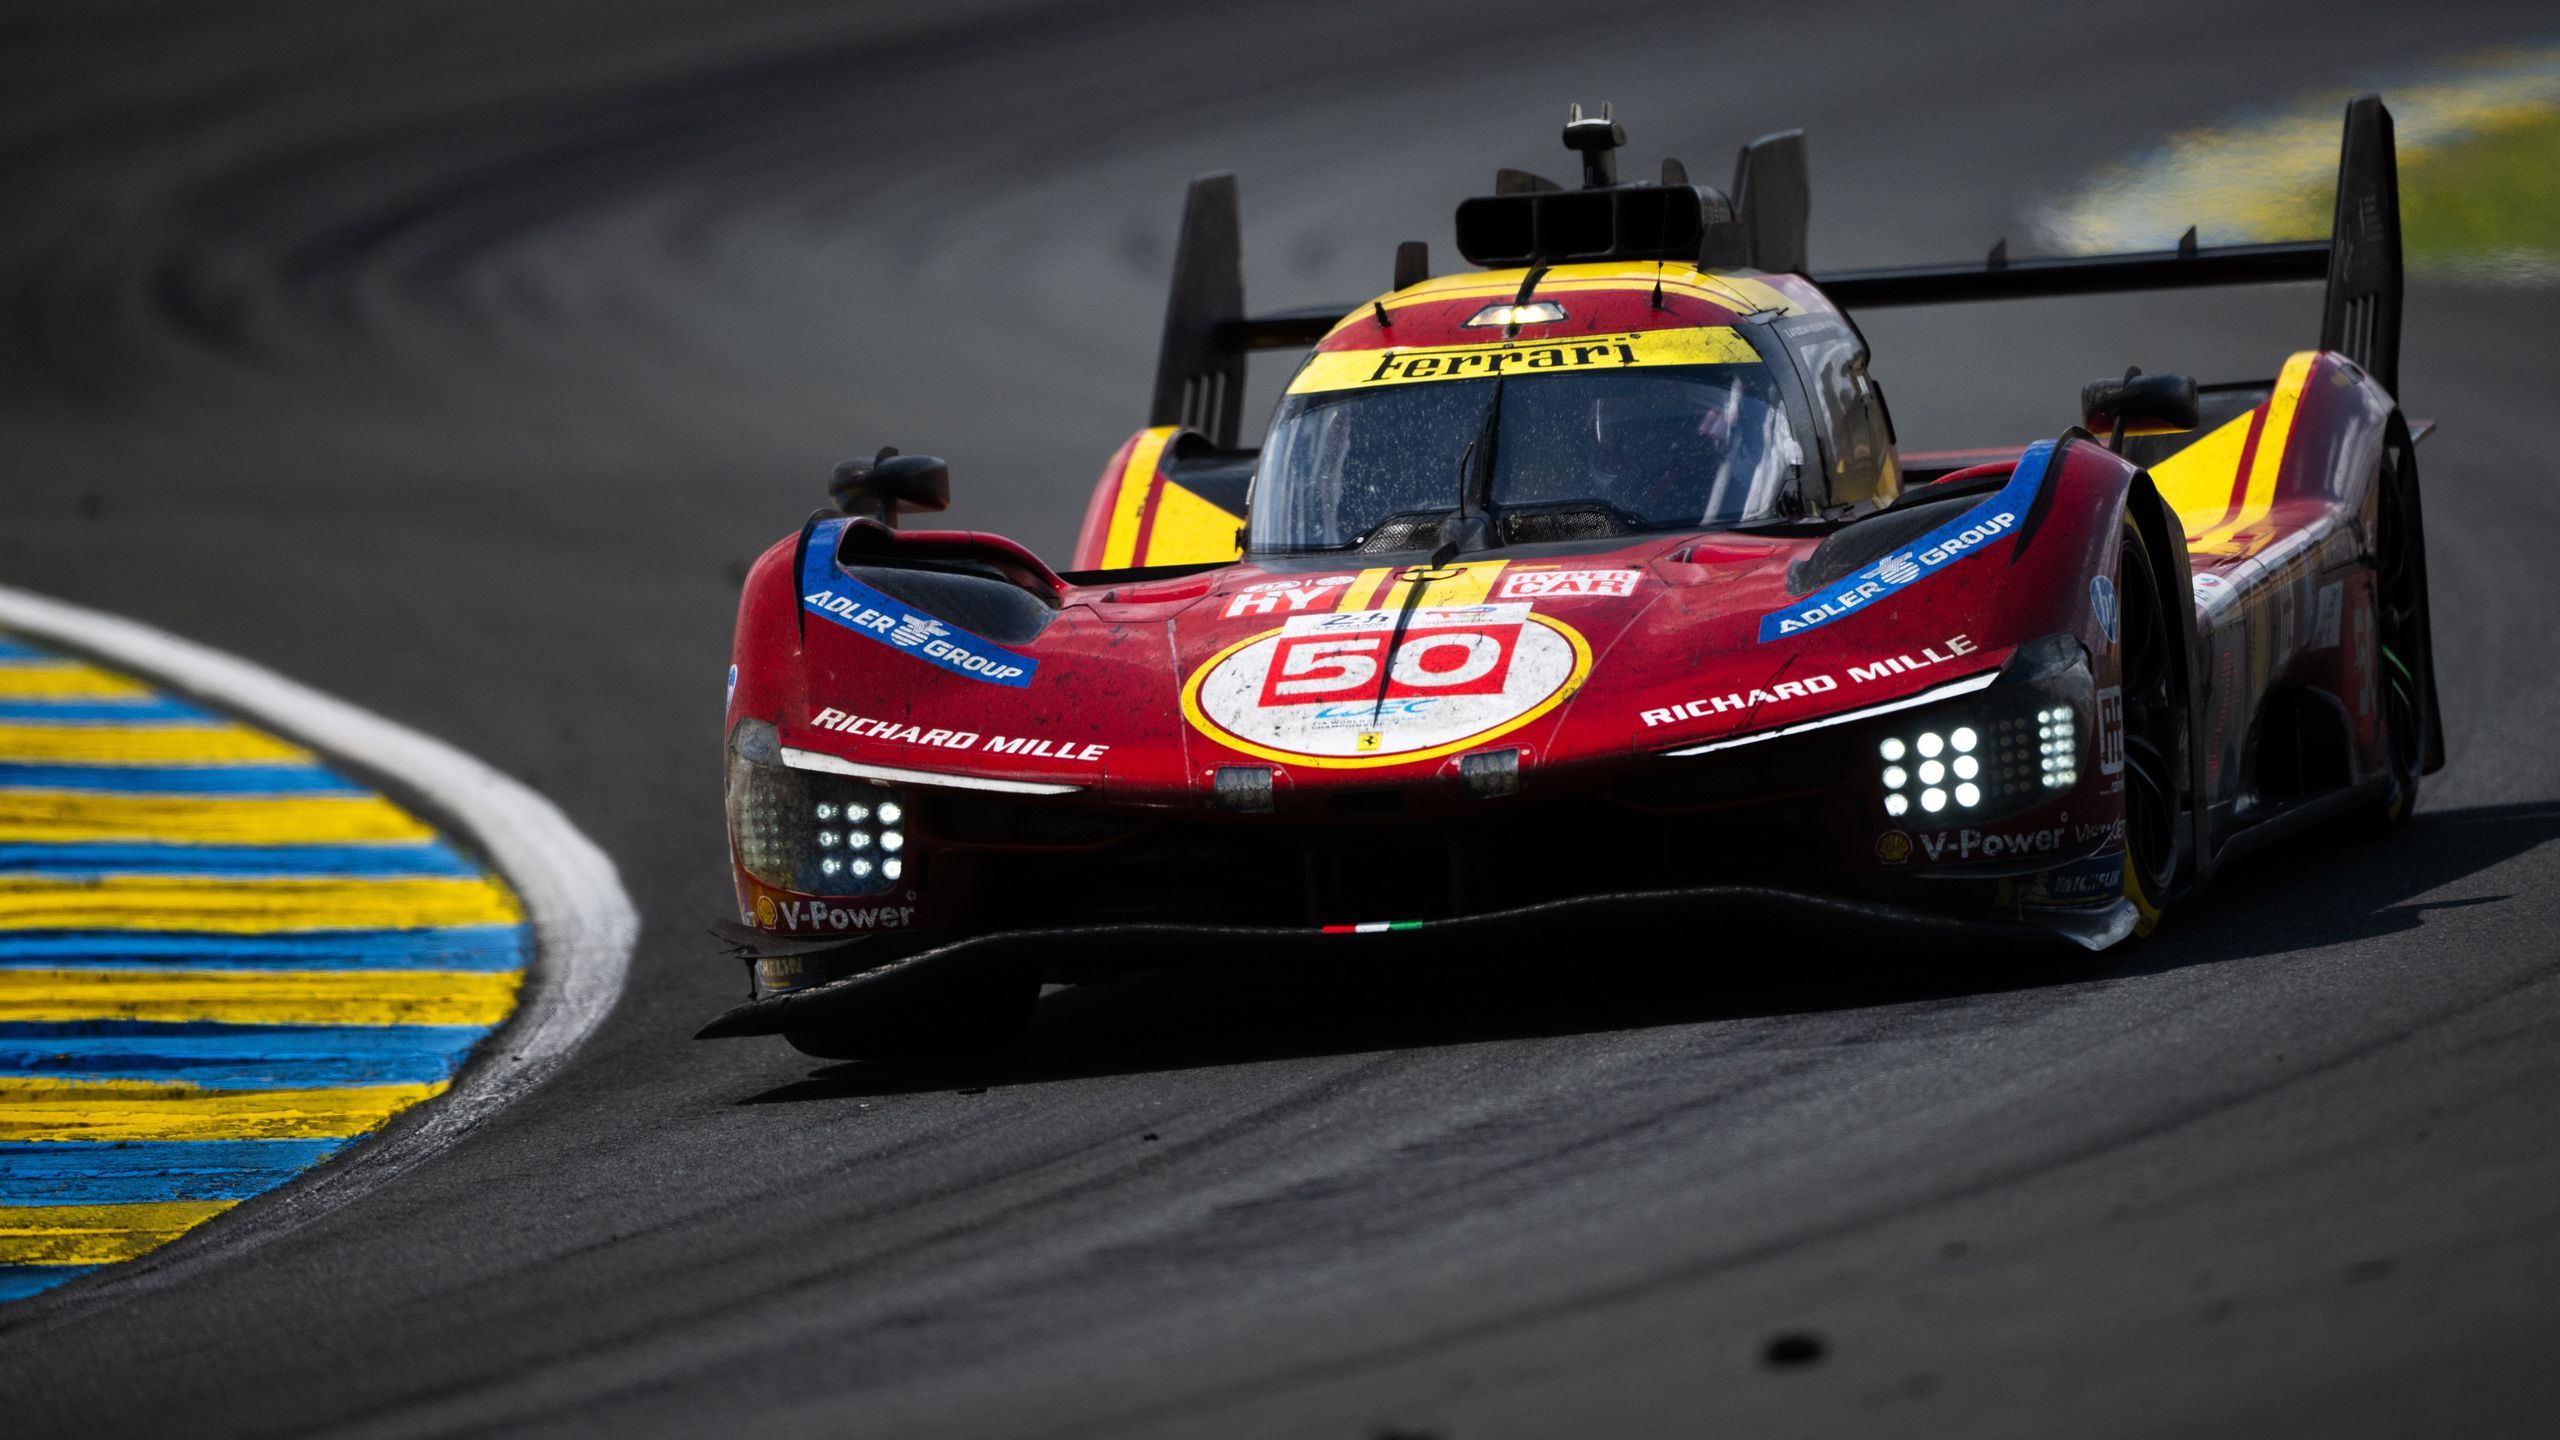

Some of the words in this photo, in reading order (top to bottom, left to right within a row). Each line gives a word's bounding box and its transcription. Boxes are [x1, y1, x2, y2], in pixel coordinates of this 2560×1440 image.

[1362, 337, 1640, 383] Ferrari
[1510, 580, 1625, 595] CAR
[1513, 571, 1631, 581] HYPER
[1779, 581, 1886, 634] ADLER
[1919, 512, 2017, 567] GROUP
[1225, 586, 1334, 618] HY
[804, 590, 887, 635] ADLER
[922, 639, 1024, 681] GROUP
[1274, 632, 1502, 697] 50
[1640, 673, 1838, 728] RICHARD
[1847, 634, 1979, 684] MILLE
[811, 706, 981, 750] RICHARD
[981, 735, 1110, 762] MILLE
[1919, 827, 2065, 862] V-Power
[778, 900, 915, 931] V-Power
